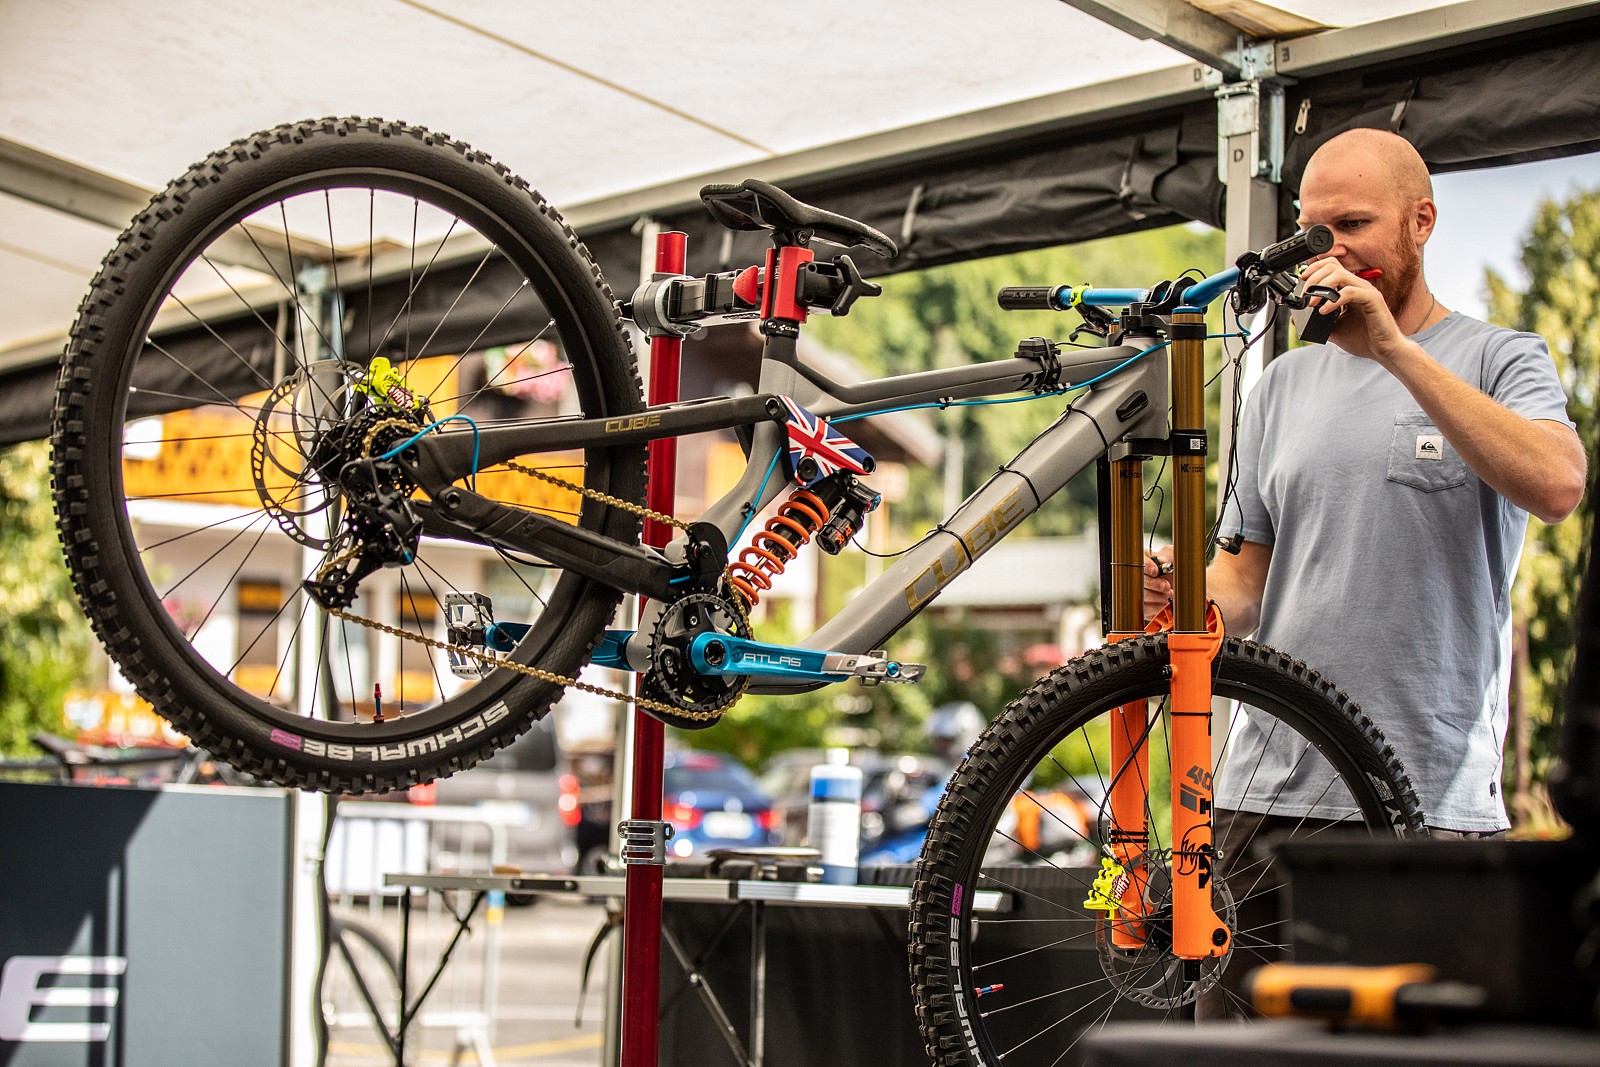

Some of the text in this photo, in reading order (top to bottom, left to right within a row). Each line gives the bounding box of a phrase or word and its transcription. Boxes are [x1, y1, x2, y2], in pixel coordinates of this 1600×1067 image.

[1194, 68, 1201, 82] D
[1234, 150, 1244, 163] D
[605, 415, 661, 433] CUBE
[905, 486, 1025, 610] CUBE
[743, 652, 802, 668] ATLAS
[303, 700, 510, 762] SCHWALBE
[1186, 765, 1212, 792] 40
[1114, 872, 1131, 901] HART
